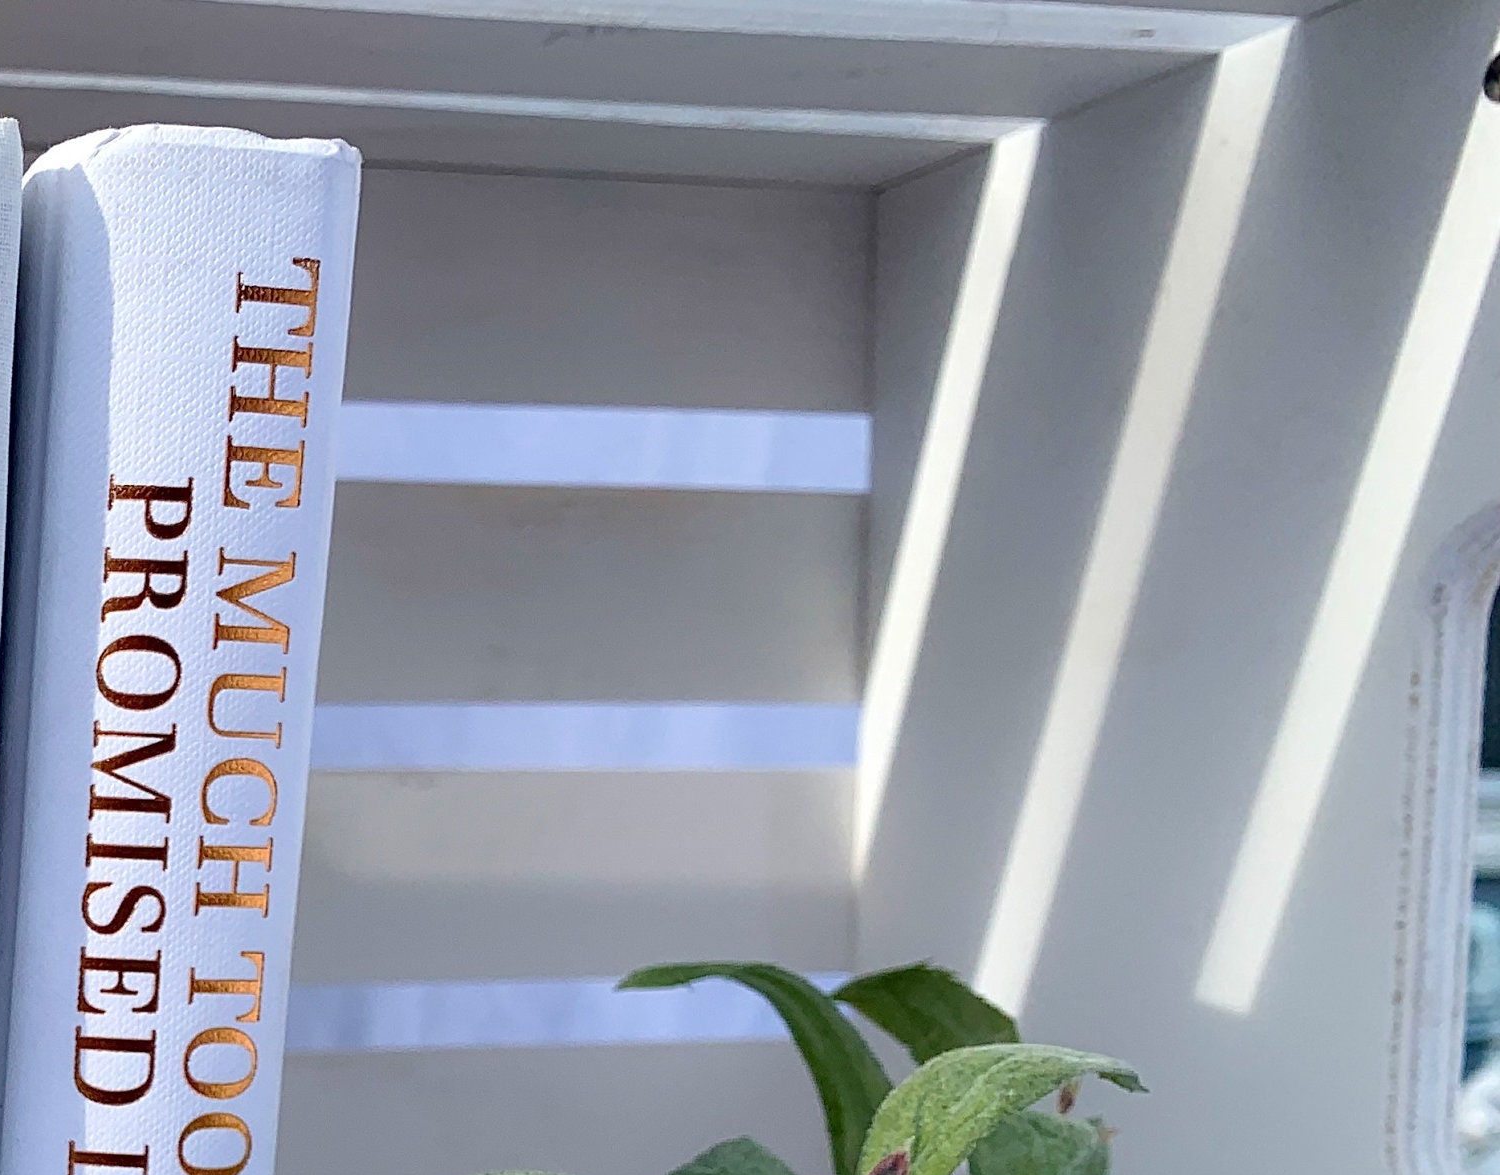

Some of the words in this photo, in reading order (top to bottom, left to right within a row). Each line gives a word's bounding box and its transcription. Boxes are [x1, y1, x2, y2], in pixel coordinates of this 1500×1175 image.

[223, 257, 321, 511] THE
[73, 474, 194, 1107] PROMISED
[194, 546, 297, 918] MUCH
